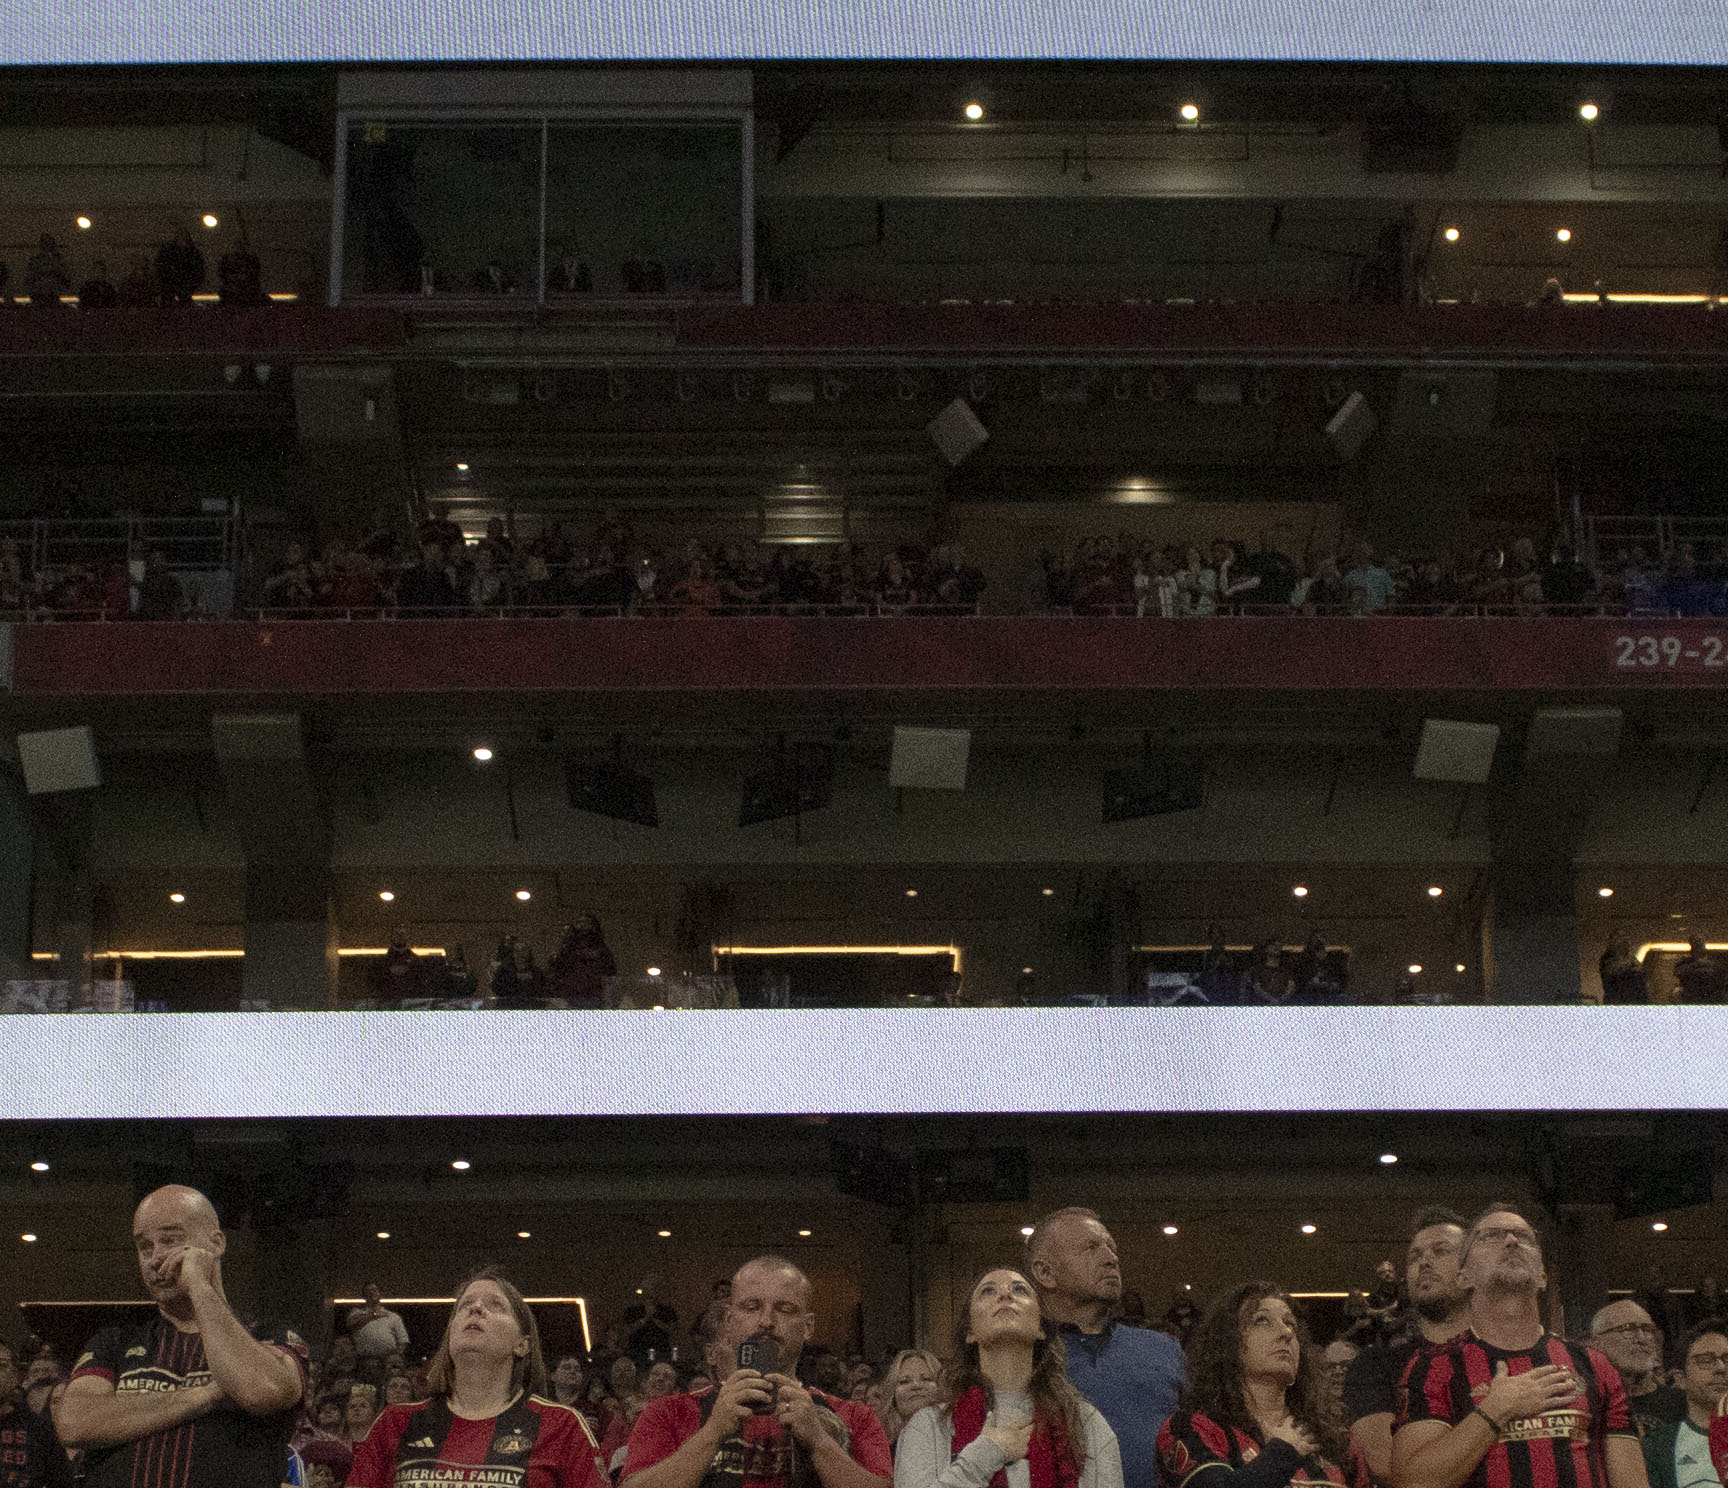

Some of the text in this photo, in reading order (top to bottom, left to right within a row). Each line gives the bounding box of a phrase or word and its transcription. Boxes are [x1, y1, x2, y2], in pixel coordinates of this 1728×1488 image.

[118, 1378, 177, 1391] AMERICA
[395, 1468, 523, 1485] AMERICAN FAMILY
